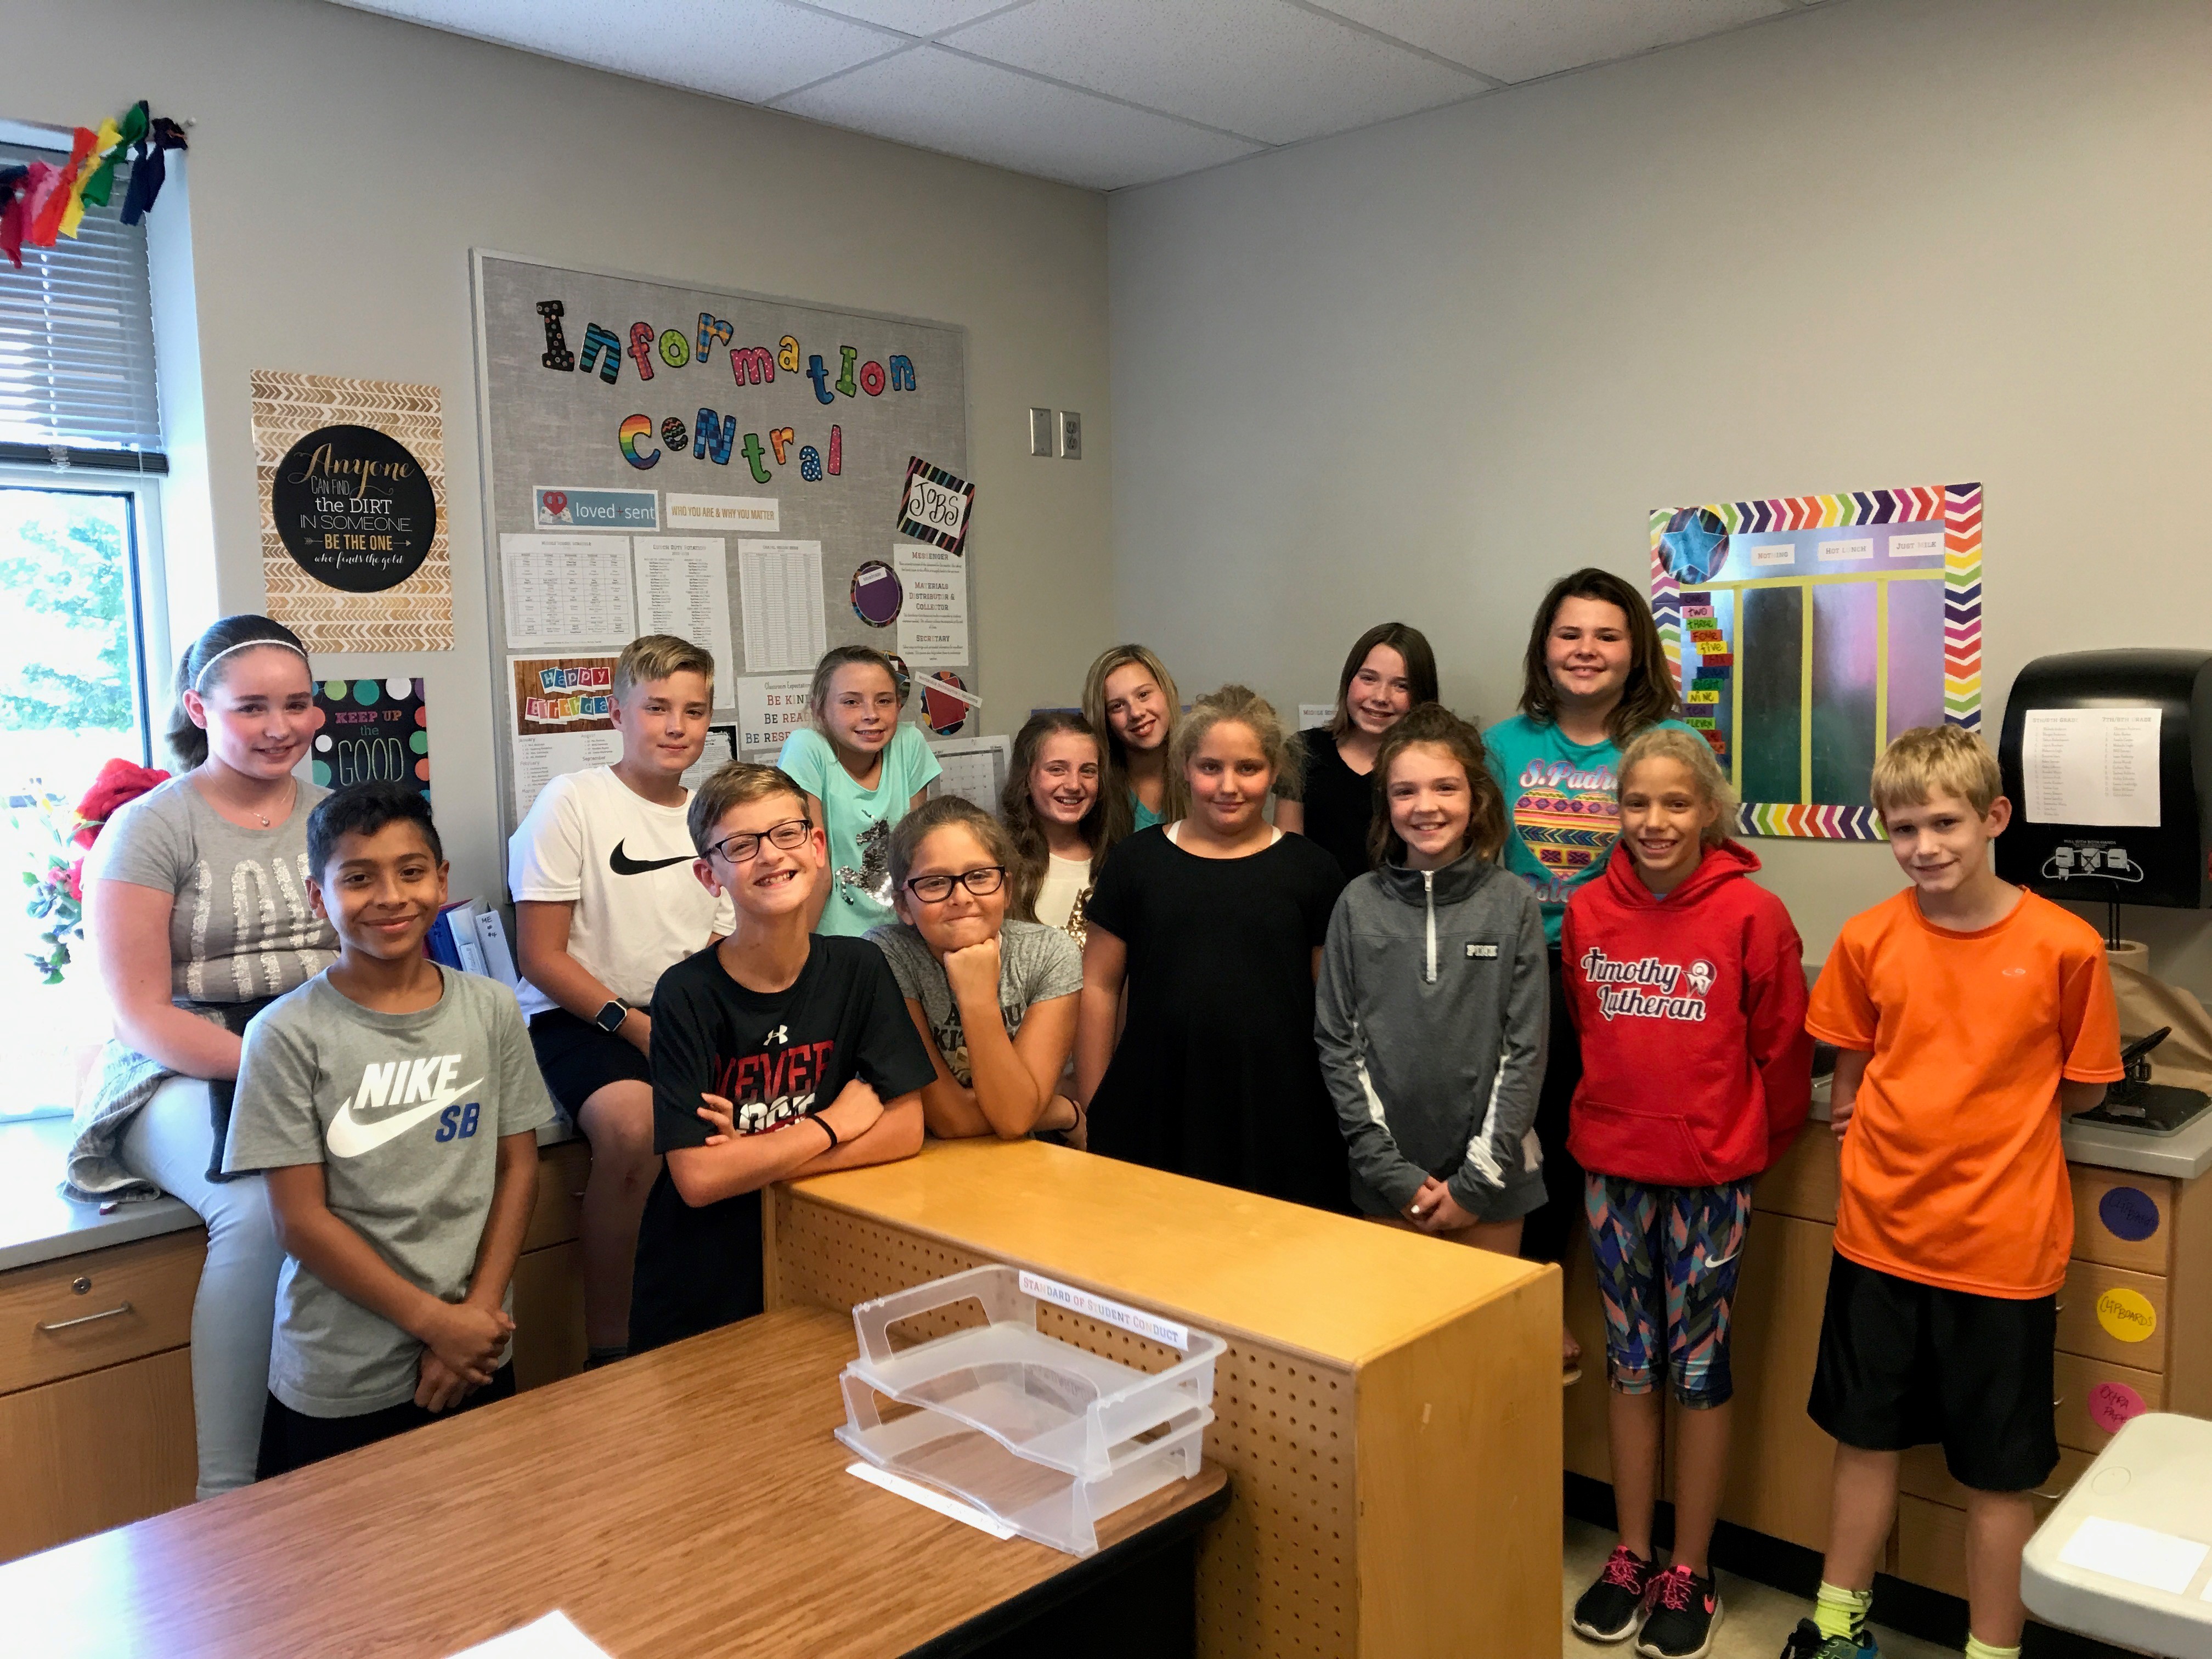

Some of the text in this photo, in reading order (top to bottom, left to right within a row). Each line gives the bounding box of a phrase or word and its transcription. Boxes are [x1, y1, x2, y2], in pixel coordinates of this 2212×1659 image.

[287, 443, 415, 498] Anyone
[311, 476, 349, 495] CAN FIND
[315, 497, 392, 514] the DIRT
[672, 506, 775, 520] WHO YOU ARE & WHY YOU MATTER
[910, 482, 959, 526] JOBS
[301, 515, 412, 532] IN SOMEONE
[324, 533, 393, 550] BE THE ONE
[314, 551, 404, 571] who finds the gold
[544, 670, 605, 685] Happy
[787, 681, 811, 690] Expectatio
[531, 699, 607, 717] Birthda
[767, 695, 781, 706] BE
[335, 710, 402, 724] KEEP UP
[764, 713, 810, 724] BE READ
[360, 725, 380, 736] the
[746, 733, 759, 744] BE
[338, 738, 404, 786] GOOD
[1519, 758, 1618, 791] S.Padr
[1581, 947, 1681, 994] Timothy
[1596, 984, 1706, 1021] Lutheran
[353, 1054, 461, 1109] NIKE
[435, 1102, 480, 1143] SB
[1023, 1277, 1178, 1342] STANDARD OF STUDENT CONDUCT
